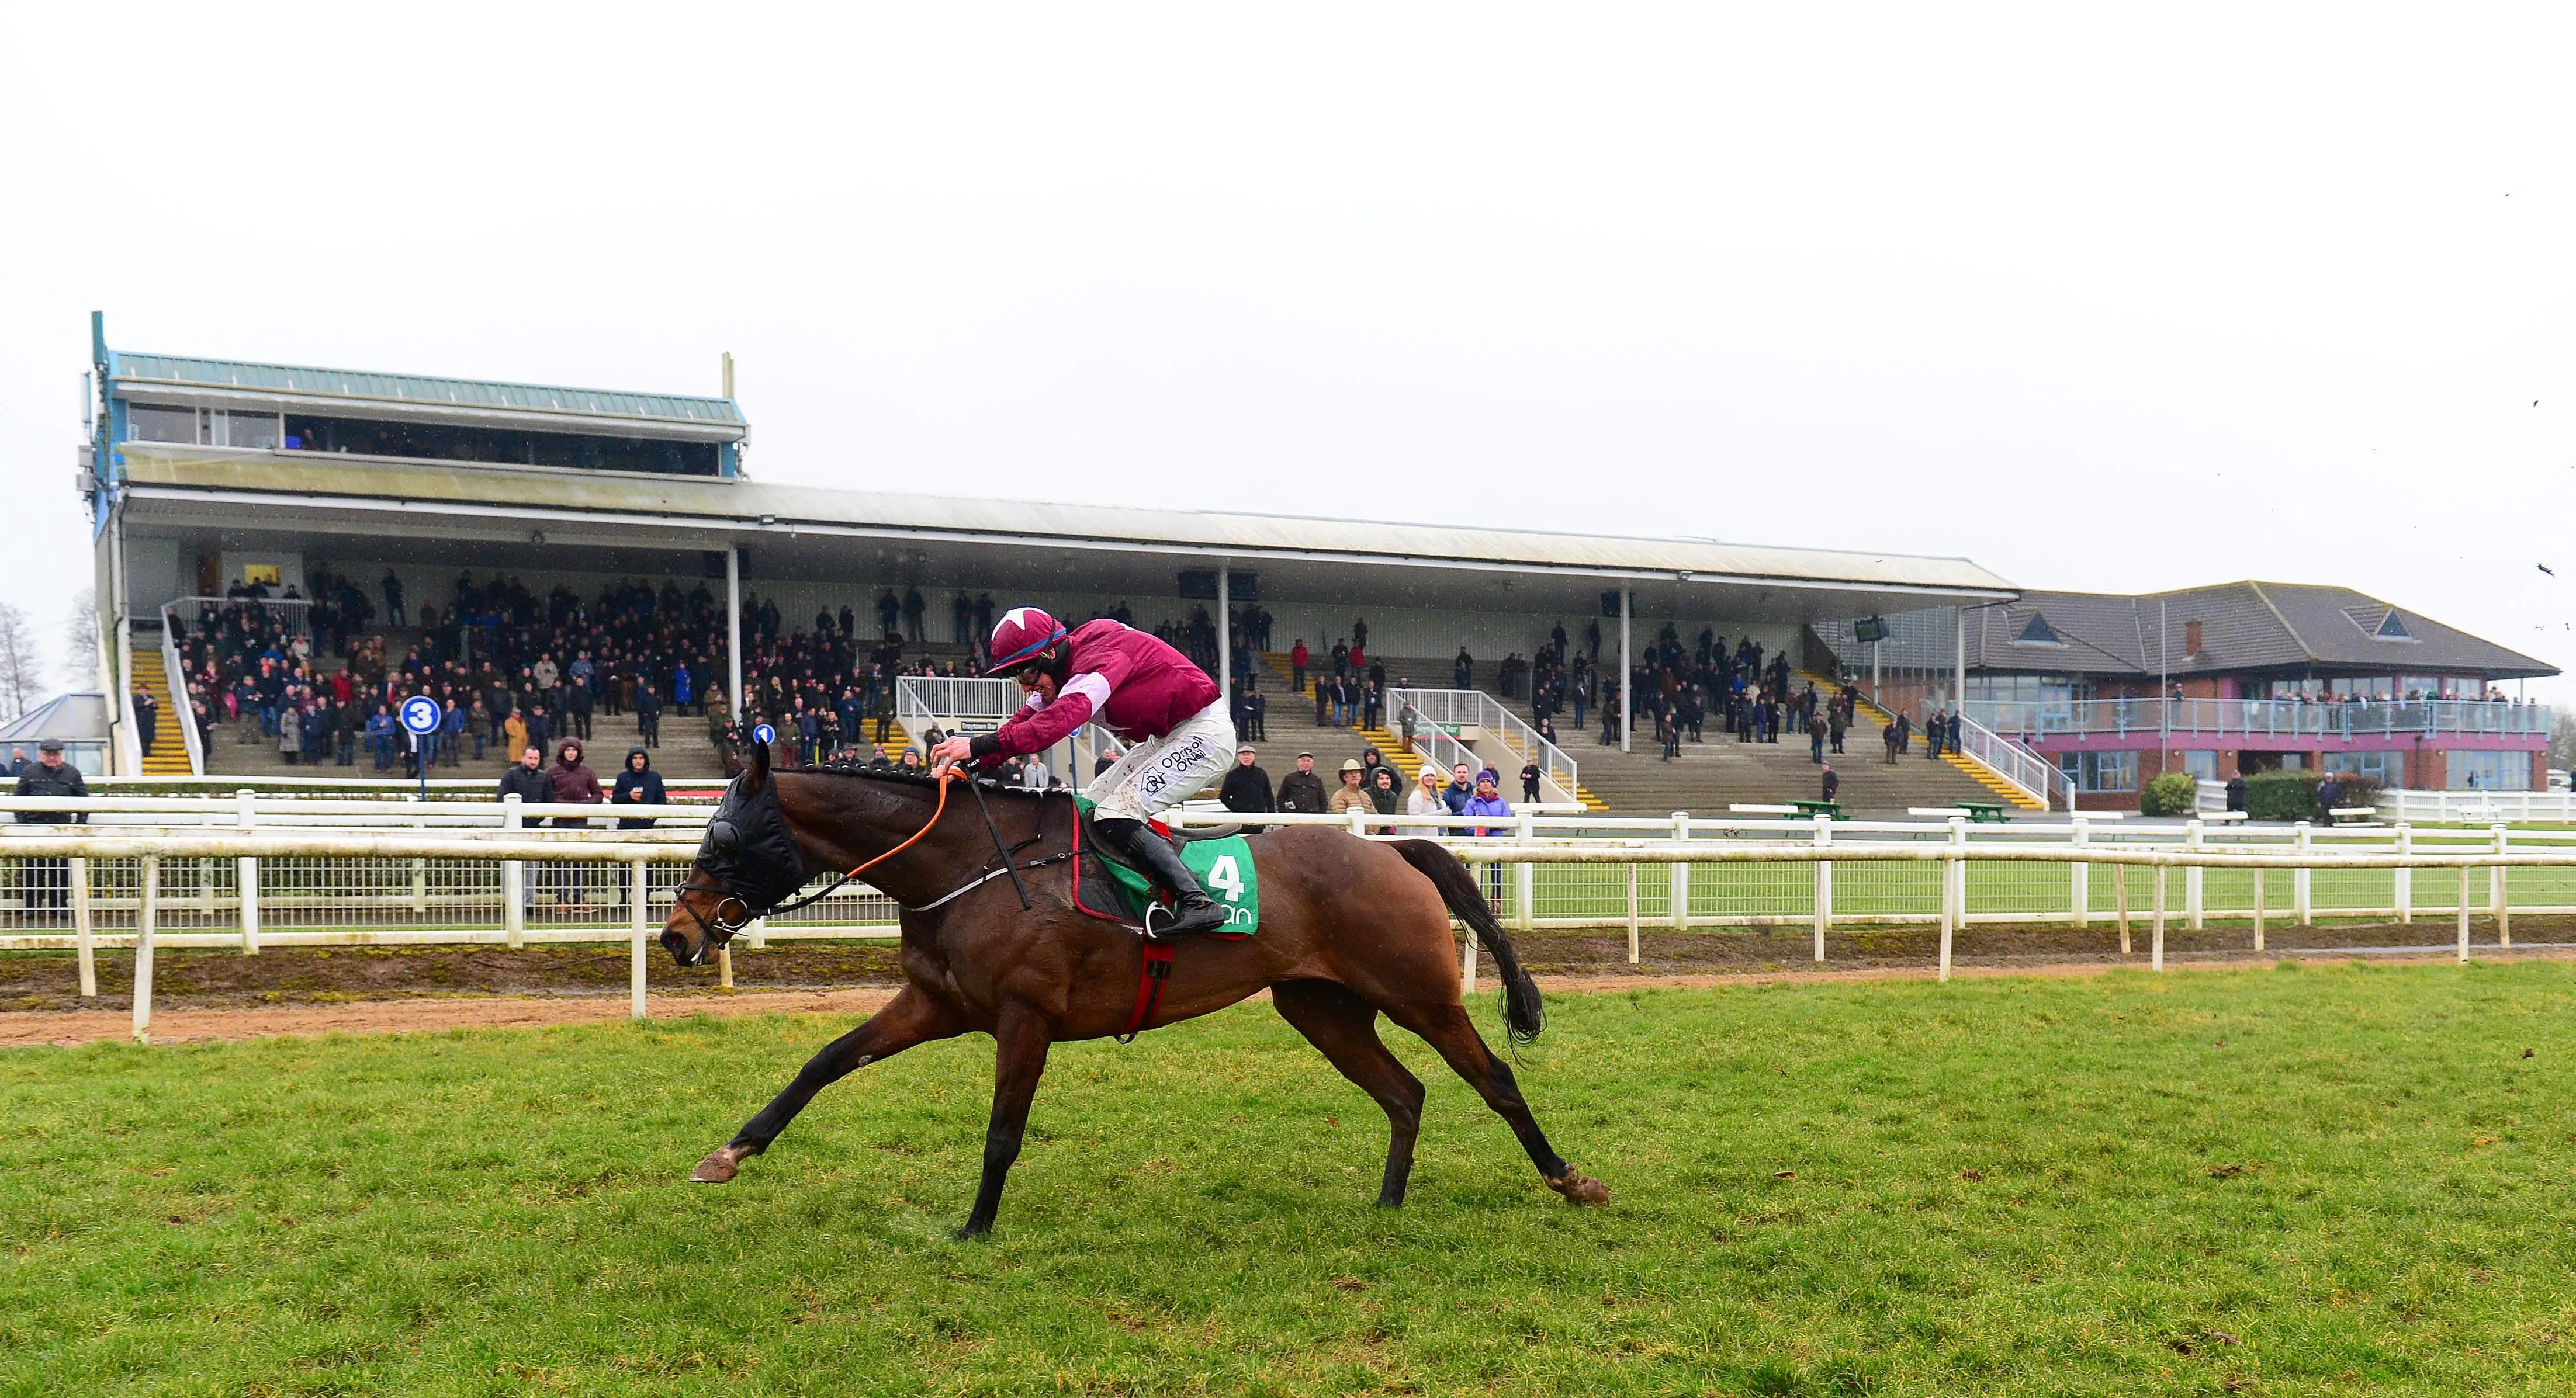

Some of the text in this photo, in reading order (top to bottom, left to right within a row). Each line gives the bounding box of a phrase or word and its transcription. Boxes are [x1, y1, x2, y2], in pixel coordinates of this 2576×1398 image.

[409, 702, 432, 729] 3
[758, 727, 767, 742] 1
[1162, 736, 1204, 768] O'Drisoll
[1208, 855, 1244, 902] 4
